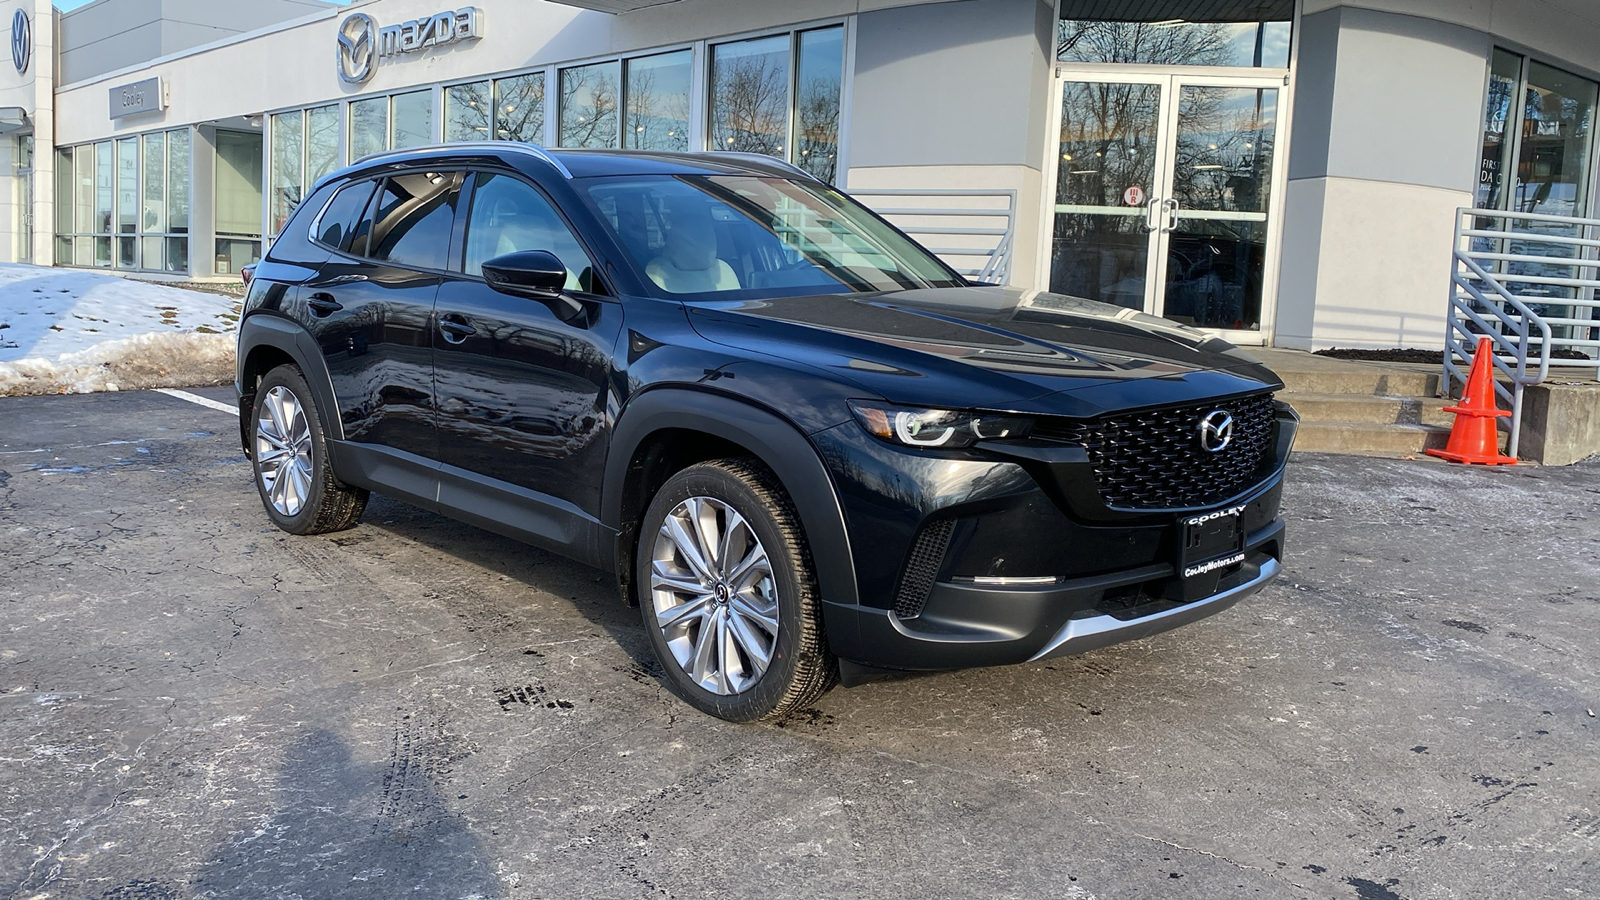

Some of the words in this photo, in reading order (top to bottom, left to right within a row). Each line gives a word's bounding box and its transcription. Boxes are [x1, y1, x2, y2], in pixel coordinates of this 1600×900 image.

[122, 85, 145, 110] Cooley
[1131, 196, 1137, 204] R
[1188, 504, 1247, 526] COOLEY
[1184, 553, 1245, 578] CooleyMotors.com
